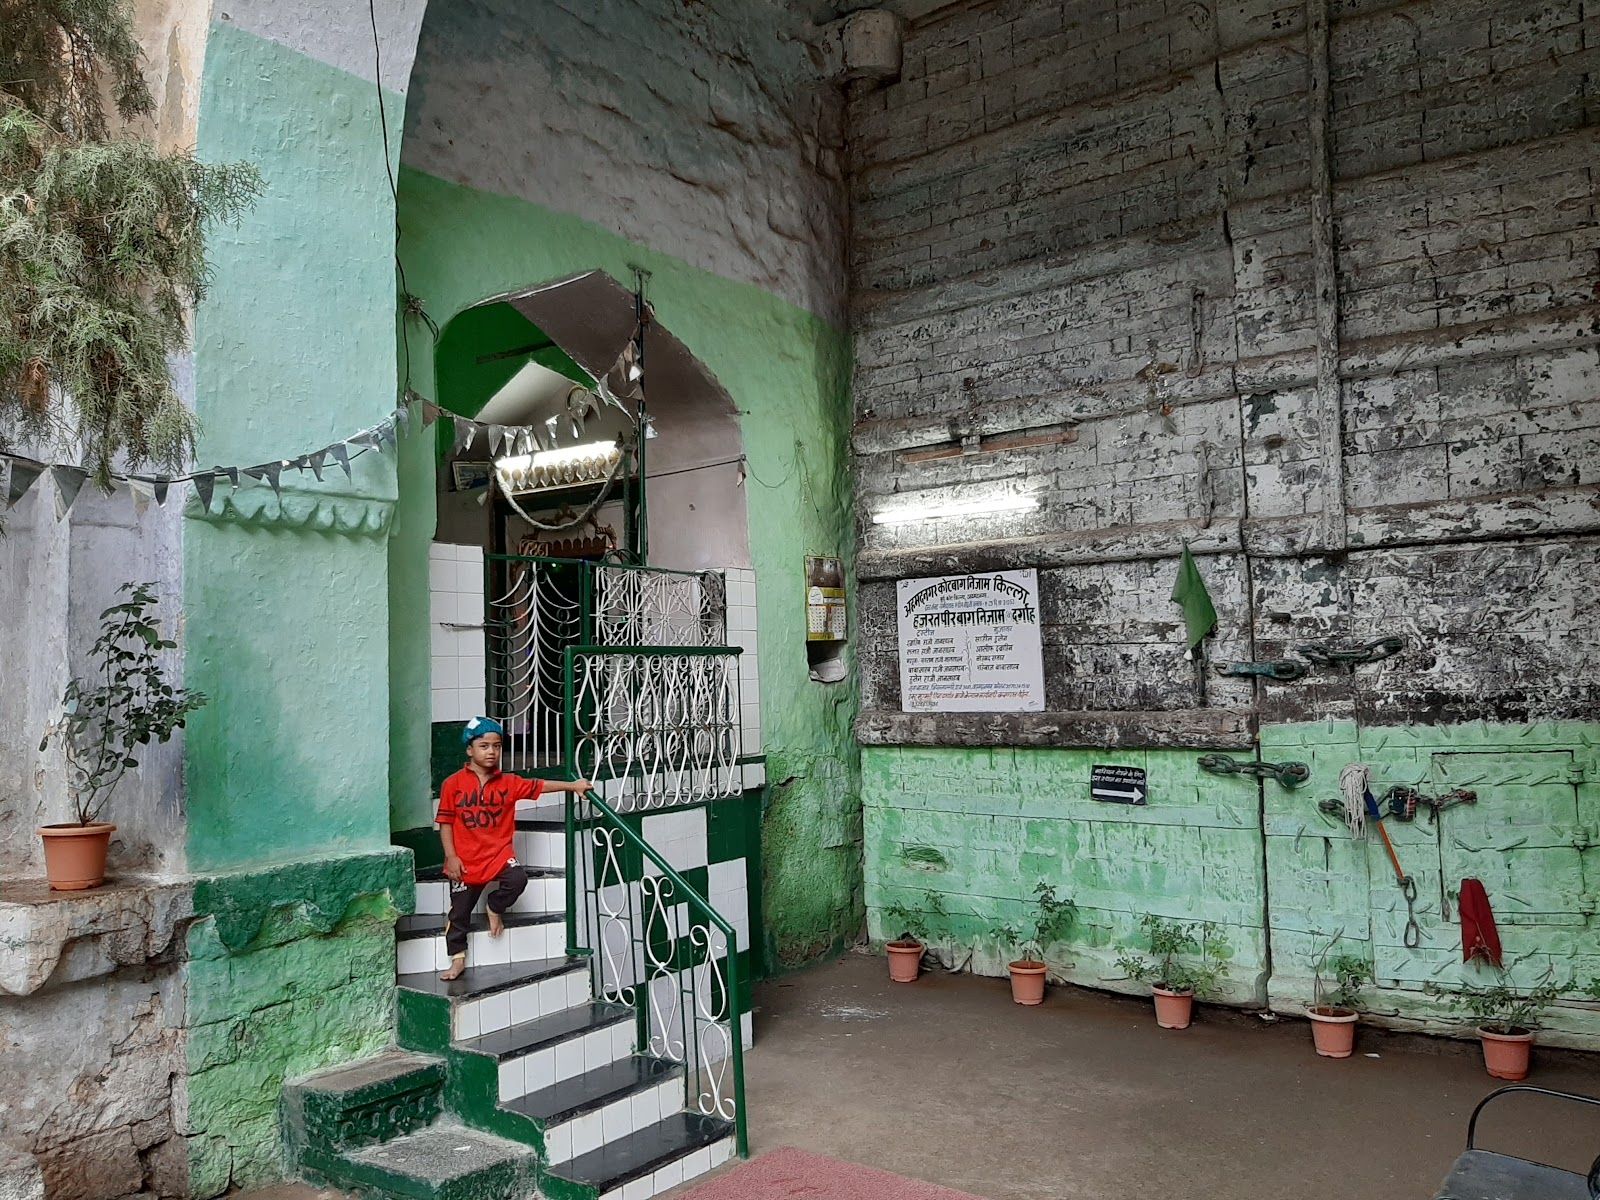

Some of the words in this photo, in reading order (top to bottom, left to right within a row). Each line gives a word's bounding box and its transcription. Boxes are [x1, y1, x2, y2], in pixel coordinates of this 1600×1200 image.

[904, 584, 938, 618] अहमदनगर
[938, 577, 966, 594] कोटबाग
[967, 575, 991, 591] निजाम
[993, 574, 1030, 604] किल्ला
[913, 613, 940, 628] हजरत
[941, 609, 956, 627] पीर
[956, 611, 975, 627] बाग
[976, 608, 1005, 625] निजाम
[1011, 603, 1035, 624] दर्गाह
[461, 808, 503, 829] BOY
